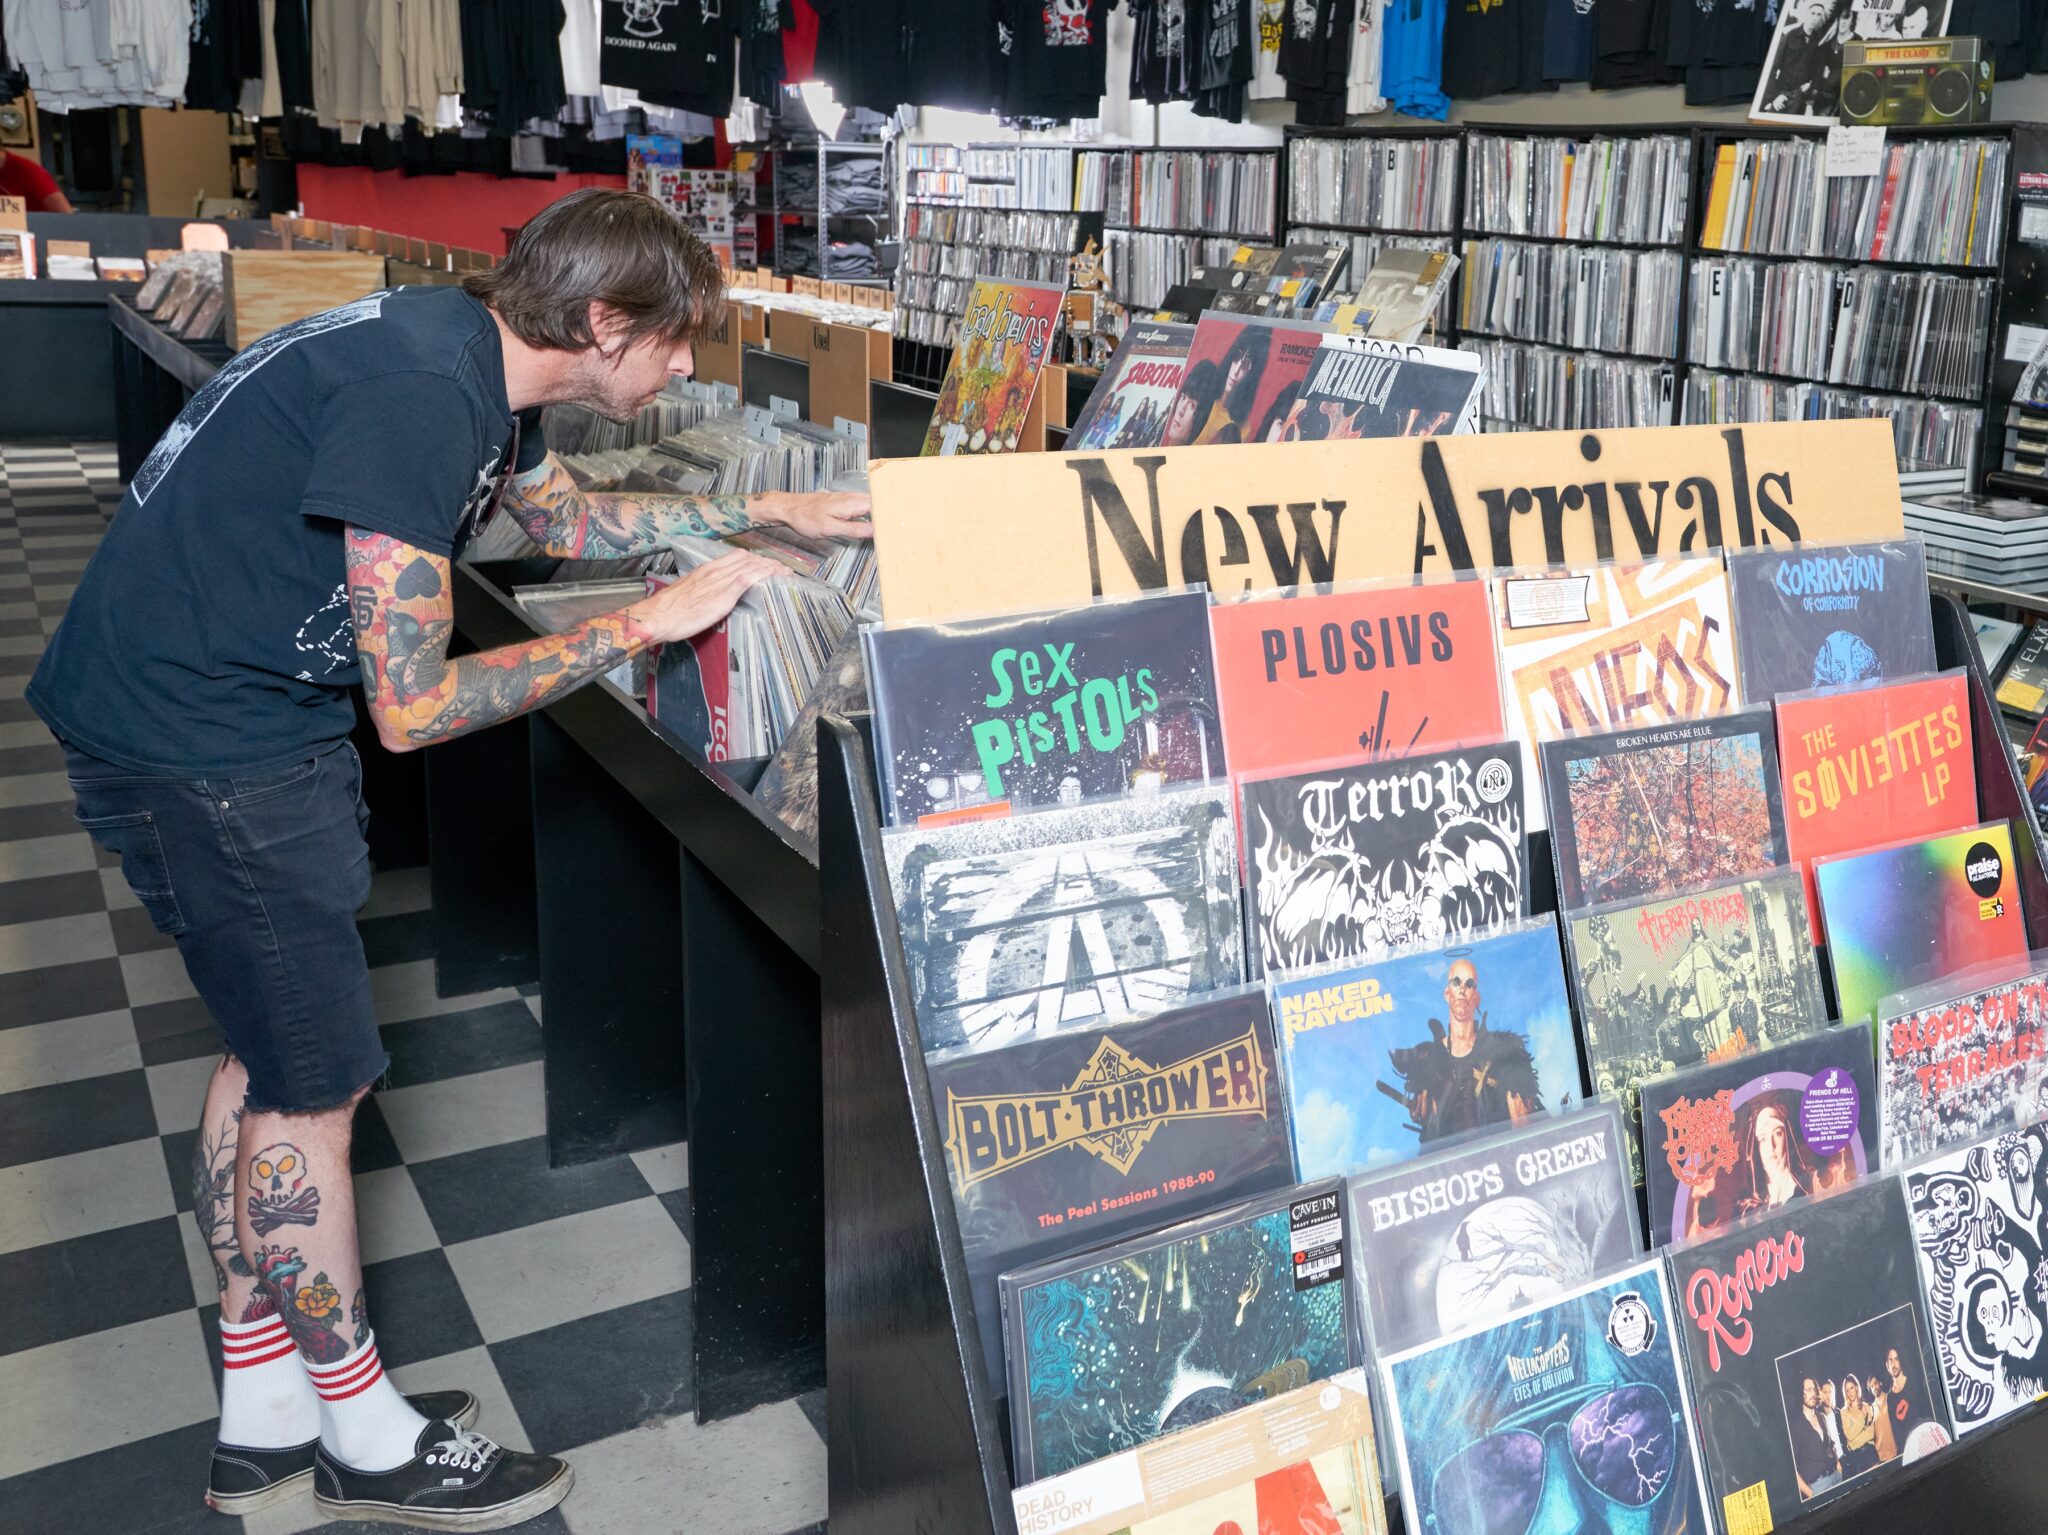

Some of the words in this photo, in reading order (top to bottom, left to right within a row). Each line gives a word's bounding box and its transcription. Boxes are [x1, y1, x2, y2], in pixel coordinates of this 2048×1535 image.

[605, 36, 646, 49] DOOMED
[647, 41, 677, 51] AGAIN
[1884, 50, 1900, 59] THE
[1388, 150, 1395, 171] B
[1742, 154, 1753, 181] A
[1712, 270, 1722, 296] E
[1844, 280, 1856, 309] D
[813, 325, 830, 351] Used
[1307, 350, 1401, 415] METALLICA
[758, 426, 765, 438] A
[1065, 455, 1346, 603] New
[1414, 428, 1801, 584] Arrivals
[1776, 554, 1885, 594] CORROSION
[1803, 598, 1815, 613] OF
[1815, 595, 1860, 612] CONFORMITY
[1261, 611, 1454, 682] PLOSIVS
[1616, 736, 1648, 749] BROKEN
[1649, 732, 1679, 746] HEARTS
[1679, 730, 1692, 741] ARE
[1694, 726, 1712, 739] BLUE
[1802, 723, 1837, 758] THE
[1921, 762, 1951, 808] LP
[1967, 857, 2000, 882] praise
[1283, 978, 1380, 1016] NAKED
[1283, 993, 1393, 1042] RAYGUN
[1893, 1005, 1976, 1057] BLOOD
[1983, 990, 2019, 1029] ON
[1916, 1029, 2046, 1098] TERRACES
[960, 1099, 1060, 1170] BOLT
[1072, 1044, 1255, 1132] THROWER
[1809, 1088, 1832, 1096] FRIENDS
[1038, 1212, 1063, 1229] The
[1068, 1205, 1098, 1221] Peel
[1101, 1187, 1158, 1212] Sessions
[1161, 1169, 1216, 1193] 1988-90
[1368, 1163, 1504, 1233] BISHOPS
[1516, 1132, 1607, 1186] GREEN
[1292, 1200, 1319, 1221] CAVE
[1322, 1195, 1336, 1211] IN
[1293, 1220, 1310, 1230] HEAVY
[1686, 1231, 1804, 1372] Romero
[1506, 1332, 1570, 1382] HELLACOPTERS
[1533, 1346, 1543, 1355] THE
[1513, 1382, 1532, 1403] EYES
[1532, 1378, 1541, 1396] OF
[1541, 1365, 1575, 1392] OBLIVION
[1017, 1489, 1066, 1520] DEAD
[1019, 1495, 1093, 1535] HISTORY
